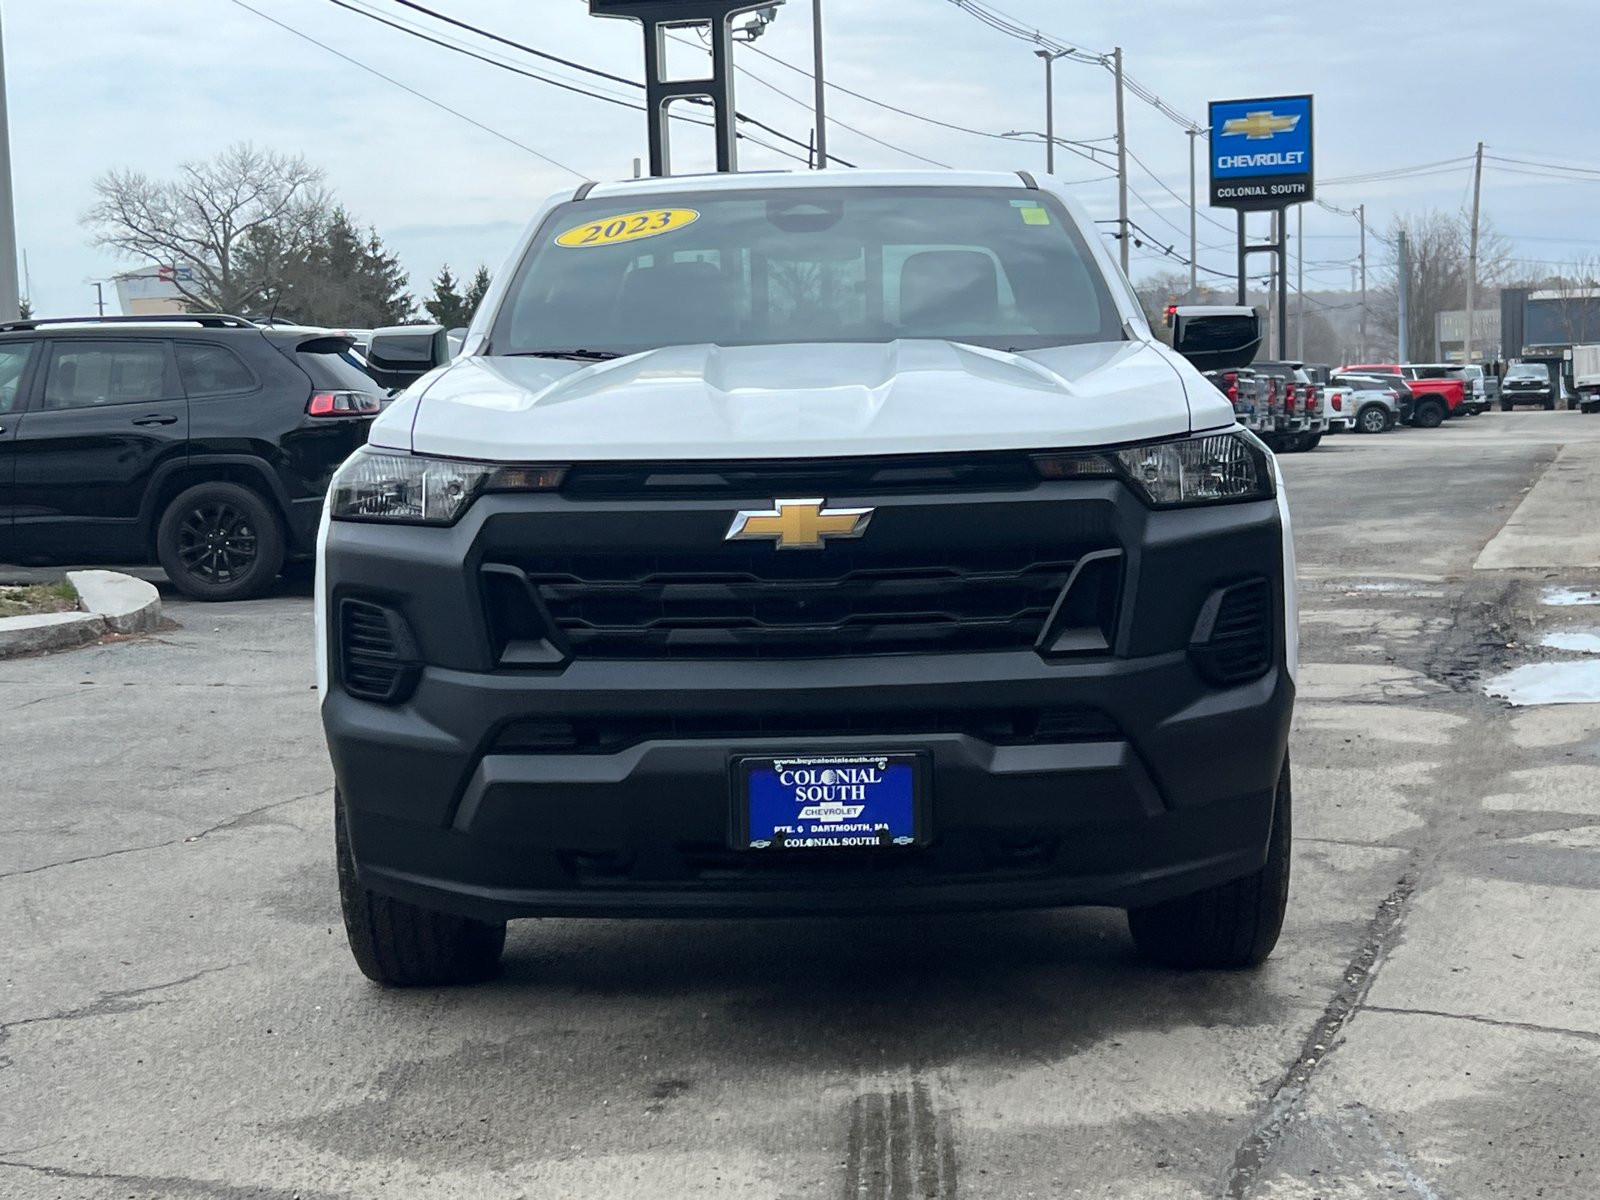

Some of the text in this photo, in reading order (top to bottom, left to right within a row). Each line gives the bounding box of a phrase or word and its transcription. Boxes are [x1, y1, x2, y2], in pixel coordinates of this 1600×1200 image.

[1218, 151, 1304, 168] CHEVROLET
[1217, 183, 1305, 198] COLONIAL SOUTH
[580, 211, 672, 243] 2023
[780, 768, 882, 786] COLONIAL
[795, 785, 866, 802] SOUTH
[805, 807, 858, 816] CHEVROLET
[797, 825, 804, 833] 6
[811, 823, 872, 833] DARTMOUTH,
[784, 836, 880, 848] COLONIAL SOUTH
